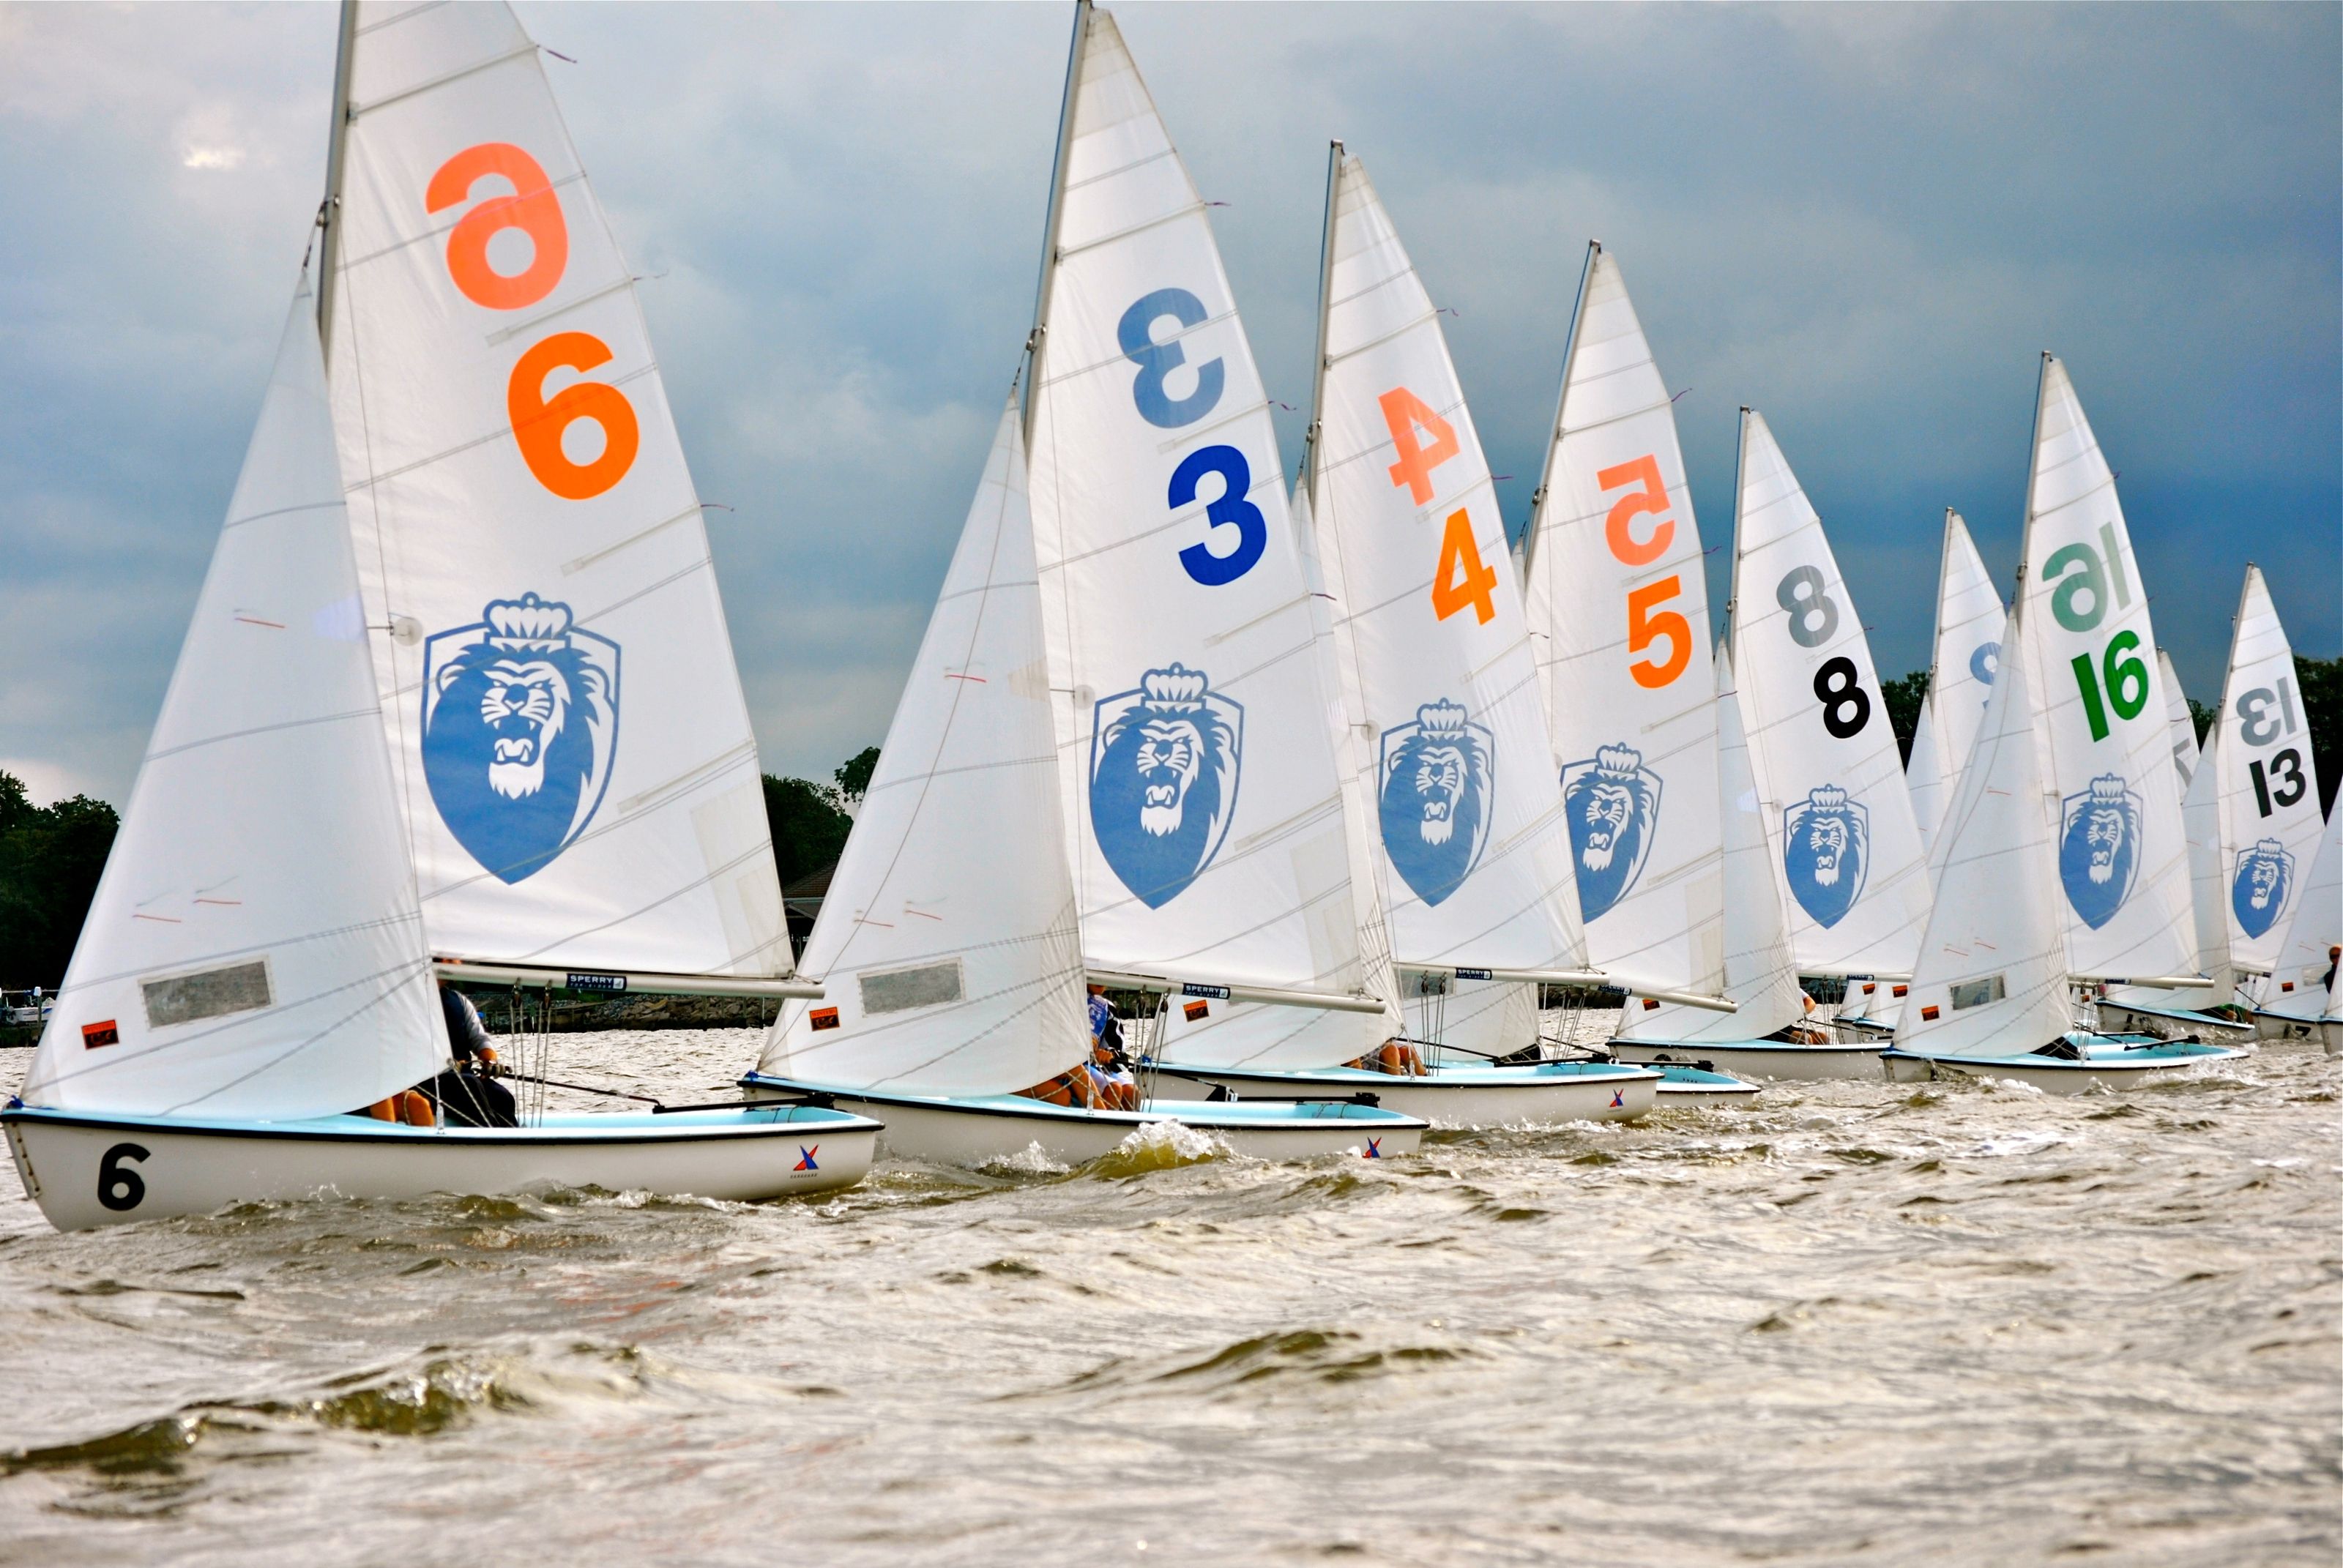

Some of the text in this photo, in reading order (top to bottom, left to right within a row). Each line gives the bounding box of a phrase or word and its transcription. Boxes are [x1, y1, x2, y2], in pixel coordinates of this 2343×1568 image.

[507, 331, 640, 501] 6
[1168, 444, 1268, 586] 3
[1431, 507, 1498, 626] 4
[1628, 575, 1693, 690] 5
[1814, 656, 1871, 739] 8
[2071, 630, 2150, 742] 16
[2249, 748, 2306, 818] 13
[570, 975, 613, 984] SPERRY
[1186, 985, 1220, 993] SPERRY
[97, 1143, 152, 1212] 6
